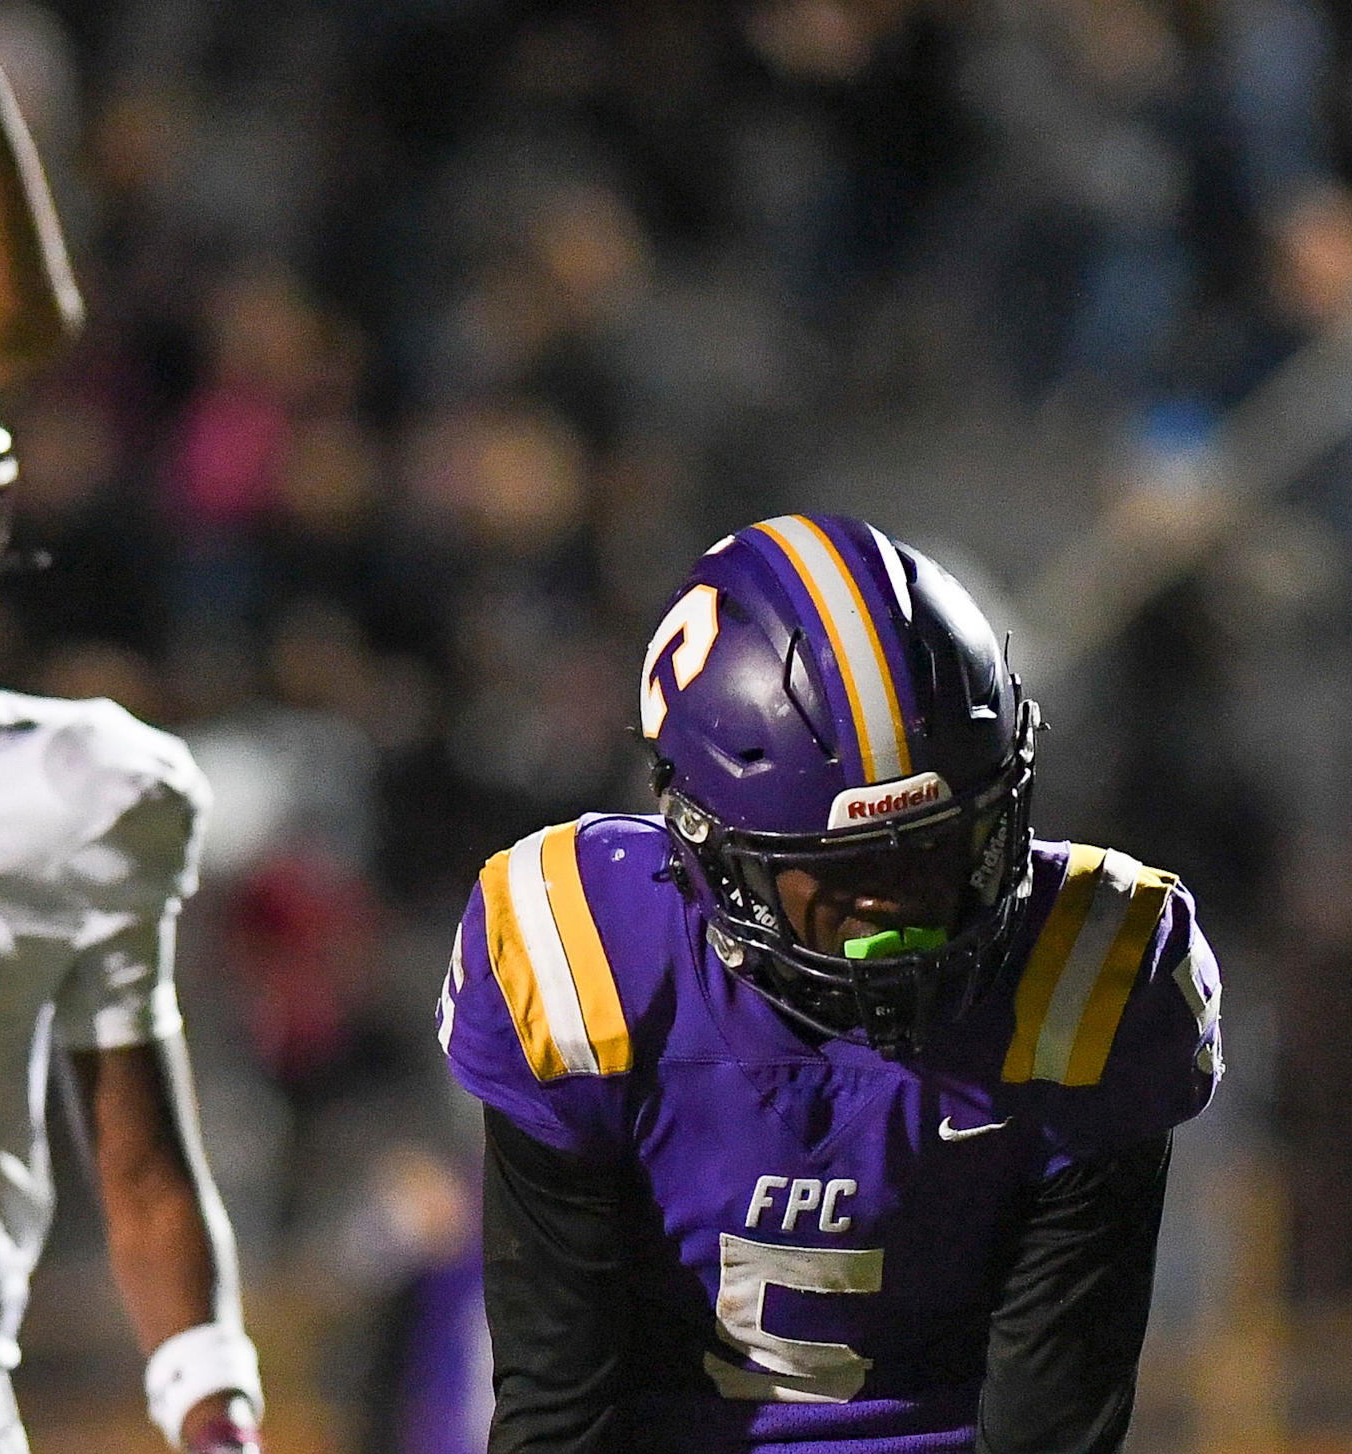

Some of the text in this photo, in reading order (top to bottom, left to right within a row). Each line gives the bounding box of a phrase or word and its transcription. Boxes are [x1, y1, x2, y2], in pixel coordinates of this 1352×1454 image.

[848, 781, 939, 820] Riddell
[745, 1174, 857, 1233] FPC
[703, 1232, 885, 1404] 5
